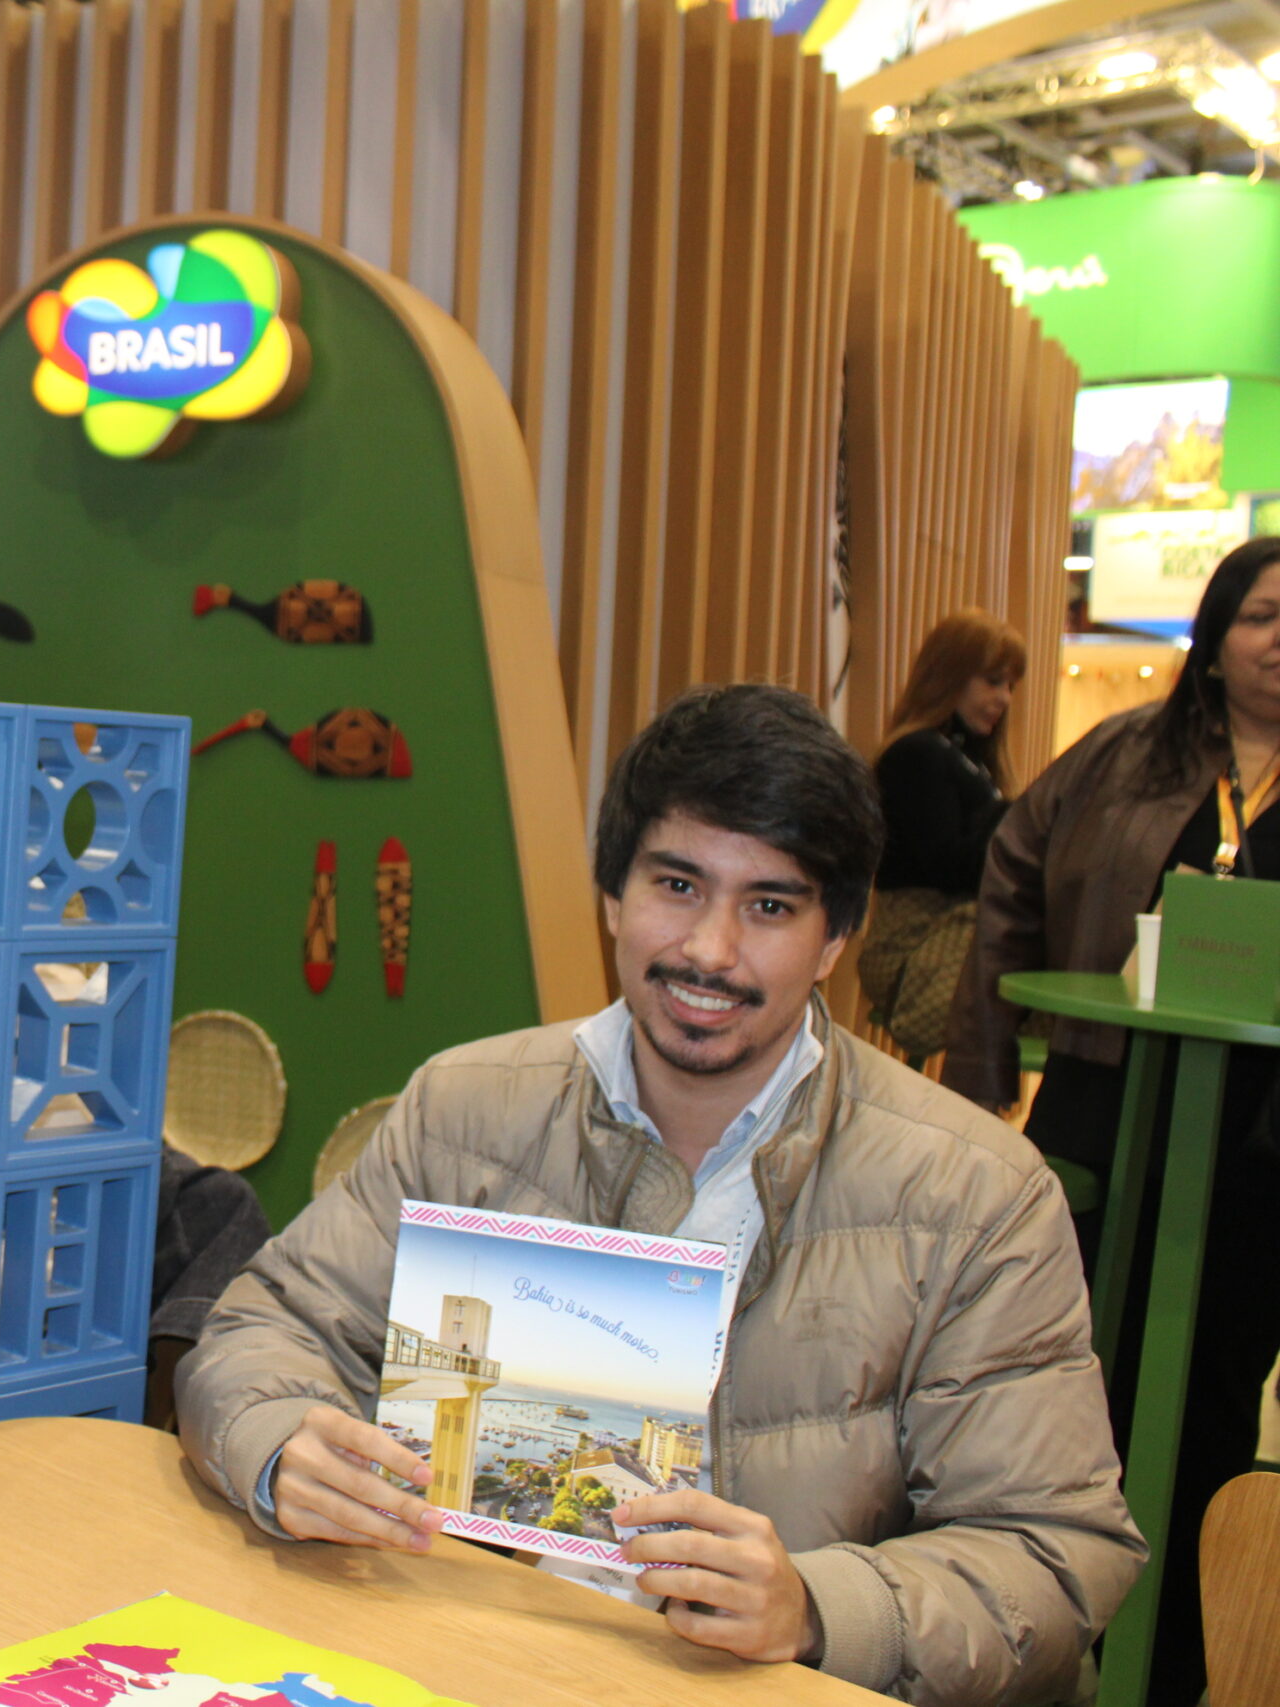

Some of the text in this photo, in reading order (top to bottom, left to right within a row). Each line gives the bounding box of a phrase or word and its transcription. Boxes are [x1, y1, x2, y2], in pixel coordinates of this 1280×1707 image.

[87, 322, 236, 377] BRASIL
[513, 1276, 564, 1312] Bahia
[565, 1301, 576, 1315] is
[577, 1305, 591, 1320] so
[590, 1311, 622, 1337] much
